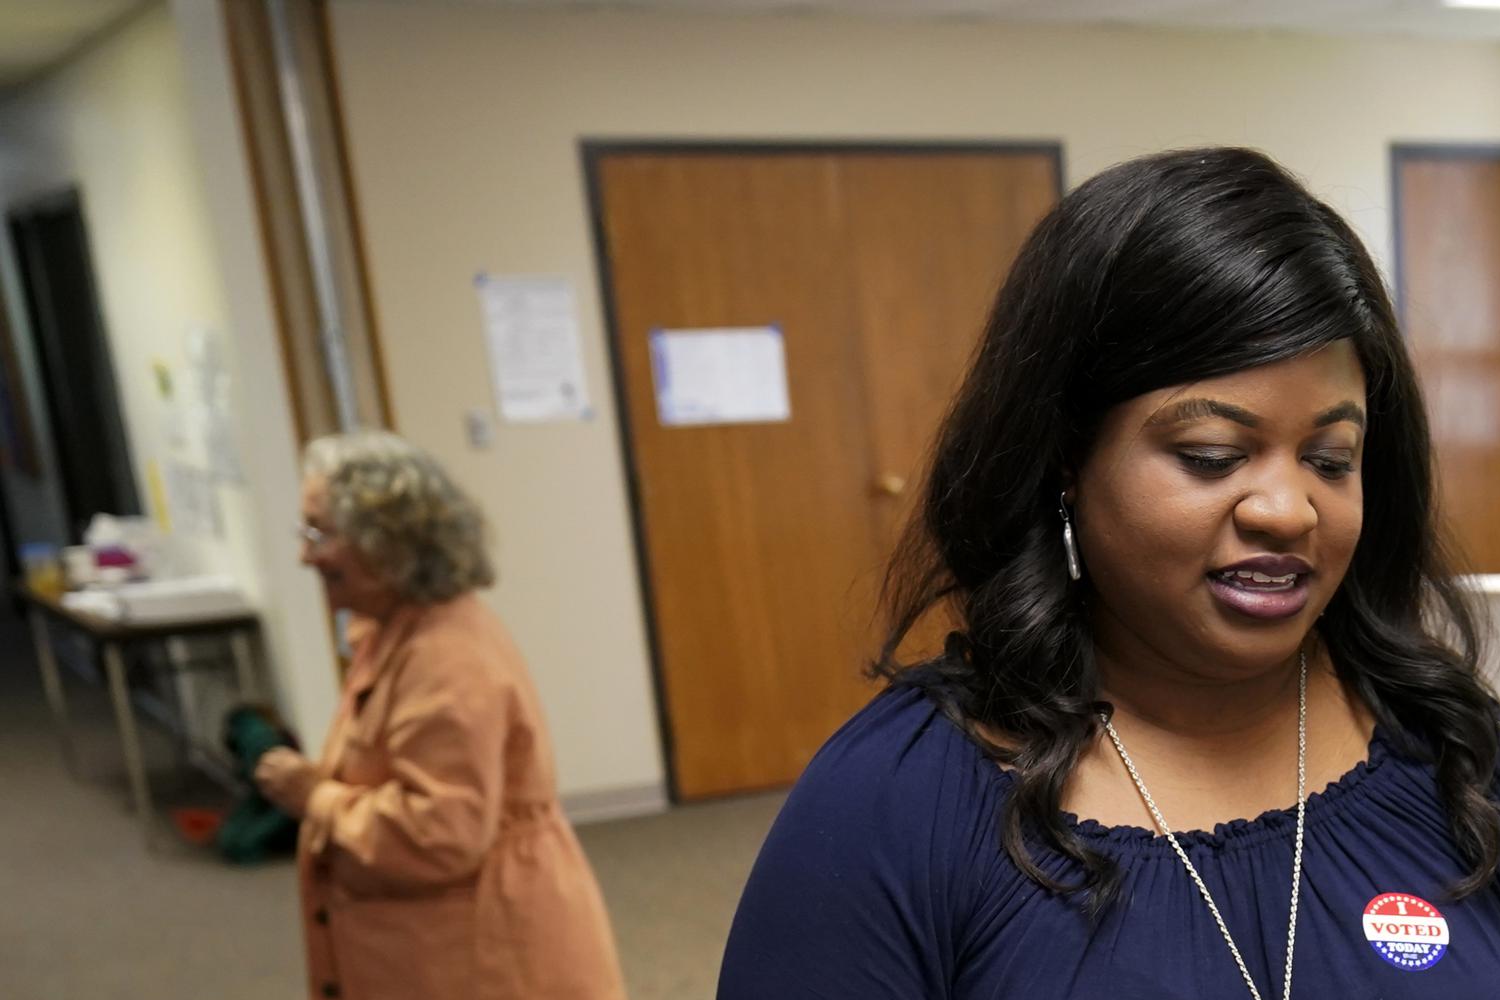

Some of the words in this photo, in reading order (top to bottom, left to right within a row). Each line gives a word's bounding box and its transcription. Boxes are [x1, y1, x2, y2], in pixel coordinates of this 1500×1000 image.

[1396, 902, 1408, 915] I
[1370, 922, 1442, 937] VOTED
[1386, 942, 1431, 954] TODAY
